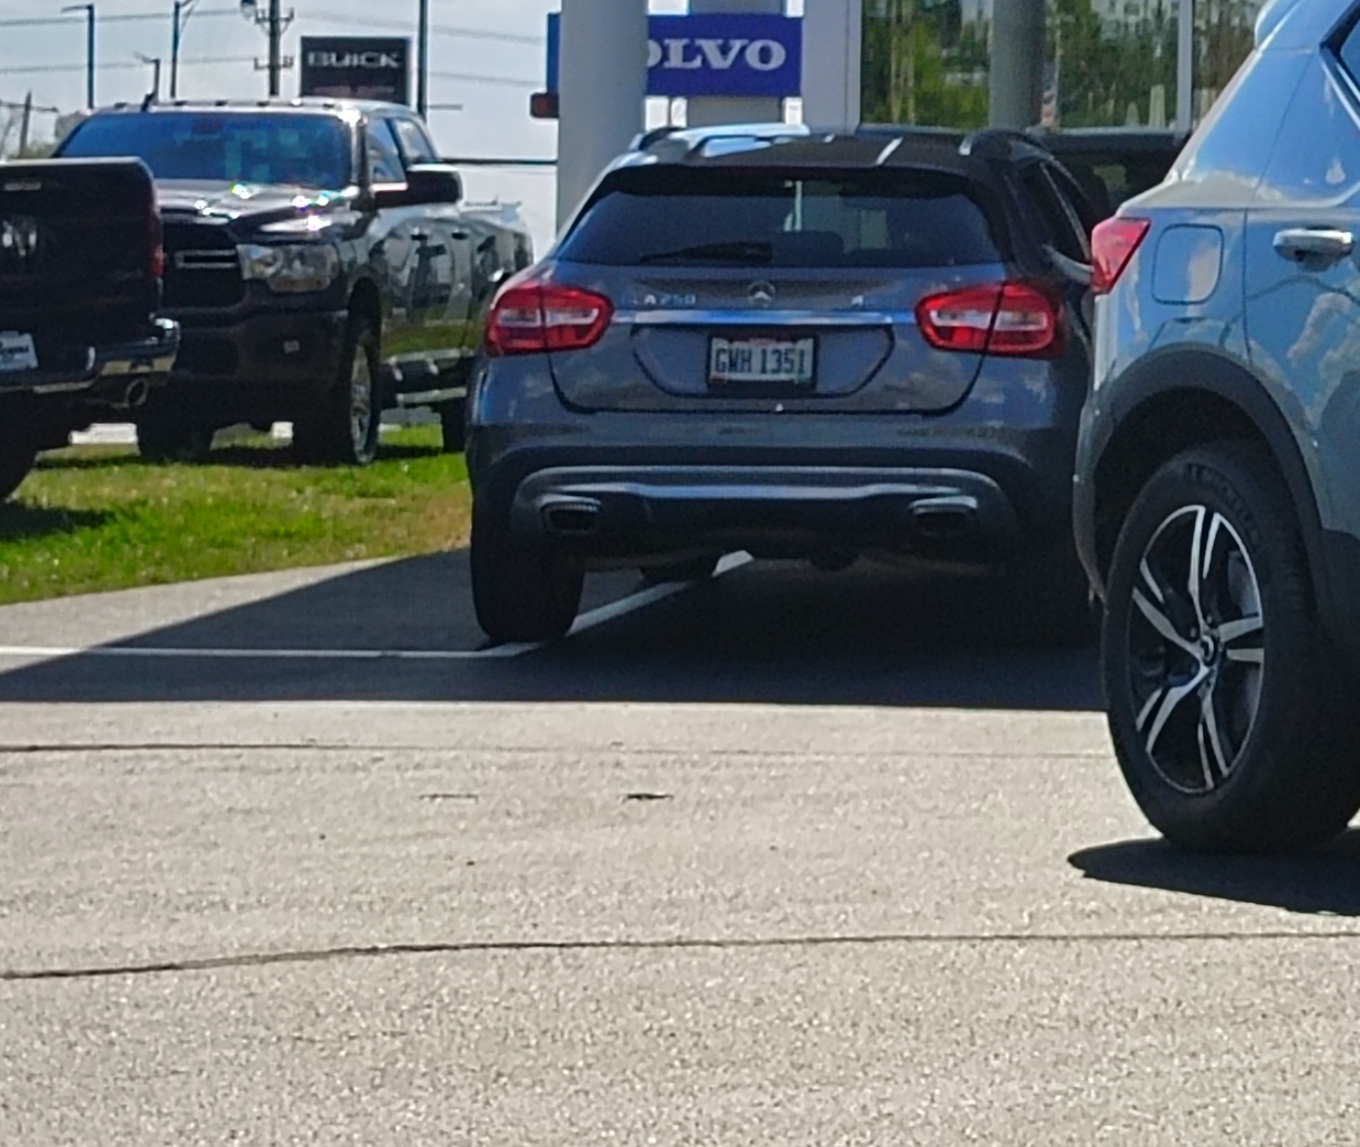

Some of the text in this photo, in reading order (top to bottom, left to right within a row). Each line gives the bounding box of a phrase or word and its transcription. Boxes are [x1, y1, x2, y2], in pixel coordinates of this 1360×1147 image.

[307, 51, 400, 68] BUICK
[647, 39, 787, 71] LVO
[760, 348, 805, 374] 1351
